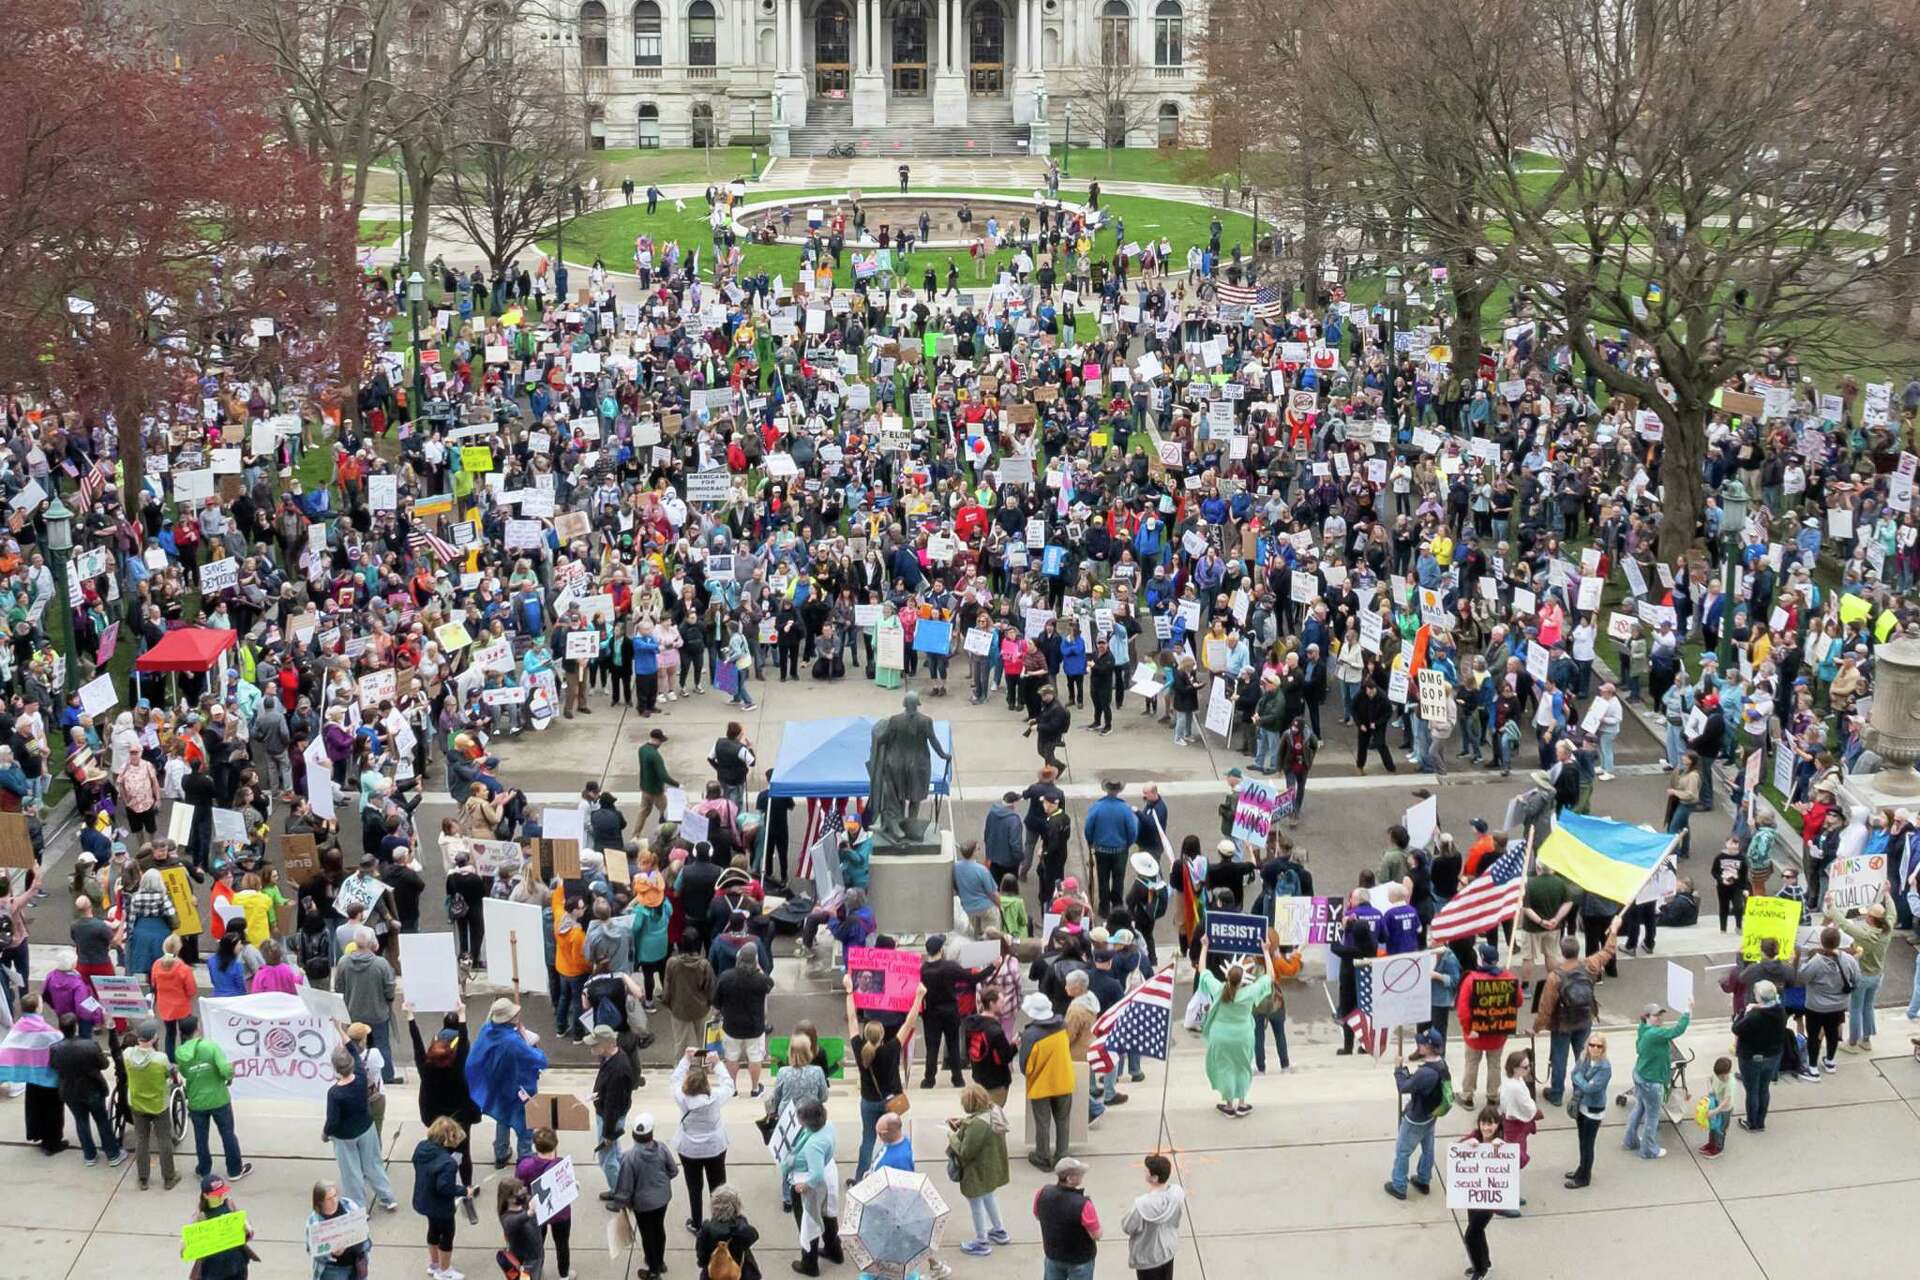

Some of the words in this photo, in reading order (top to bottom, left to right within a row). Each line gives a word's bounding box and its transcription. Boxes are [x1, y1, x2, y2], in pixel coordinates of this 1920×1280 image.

[204, 561, 226, 576] SAVE
[1420, 671, 1442, 686] OMG
[1422, 687, 1443, 701] GOP
[1243, 783, 1267, 804] NO
[1236, 808, 1270, 838] KINGS
[1834, 882, 1882, 908] QUALITY
[1211, 922, 1261, 940] RESIST!
[1475, 981, 1515, 994] HANDS
[1450, 1147, 1477, 1160] Super
[1481, 1145, 1515, 1159] callous
[1455, 1161, 1479, 1173] facist
[1485, 1163, 1510, 1173] racist
[1455, 1178, 1481, 1188] sexist
[1488, 1177, 1509, 1188] Nazi
[1468, 1189, 1503, 1203] POTUS
